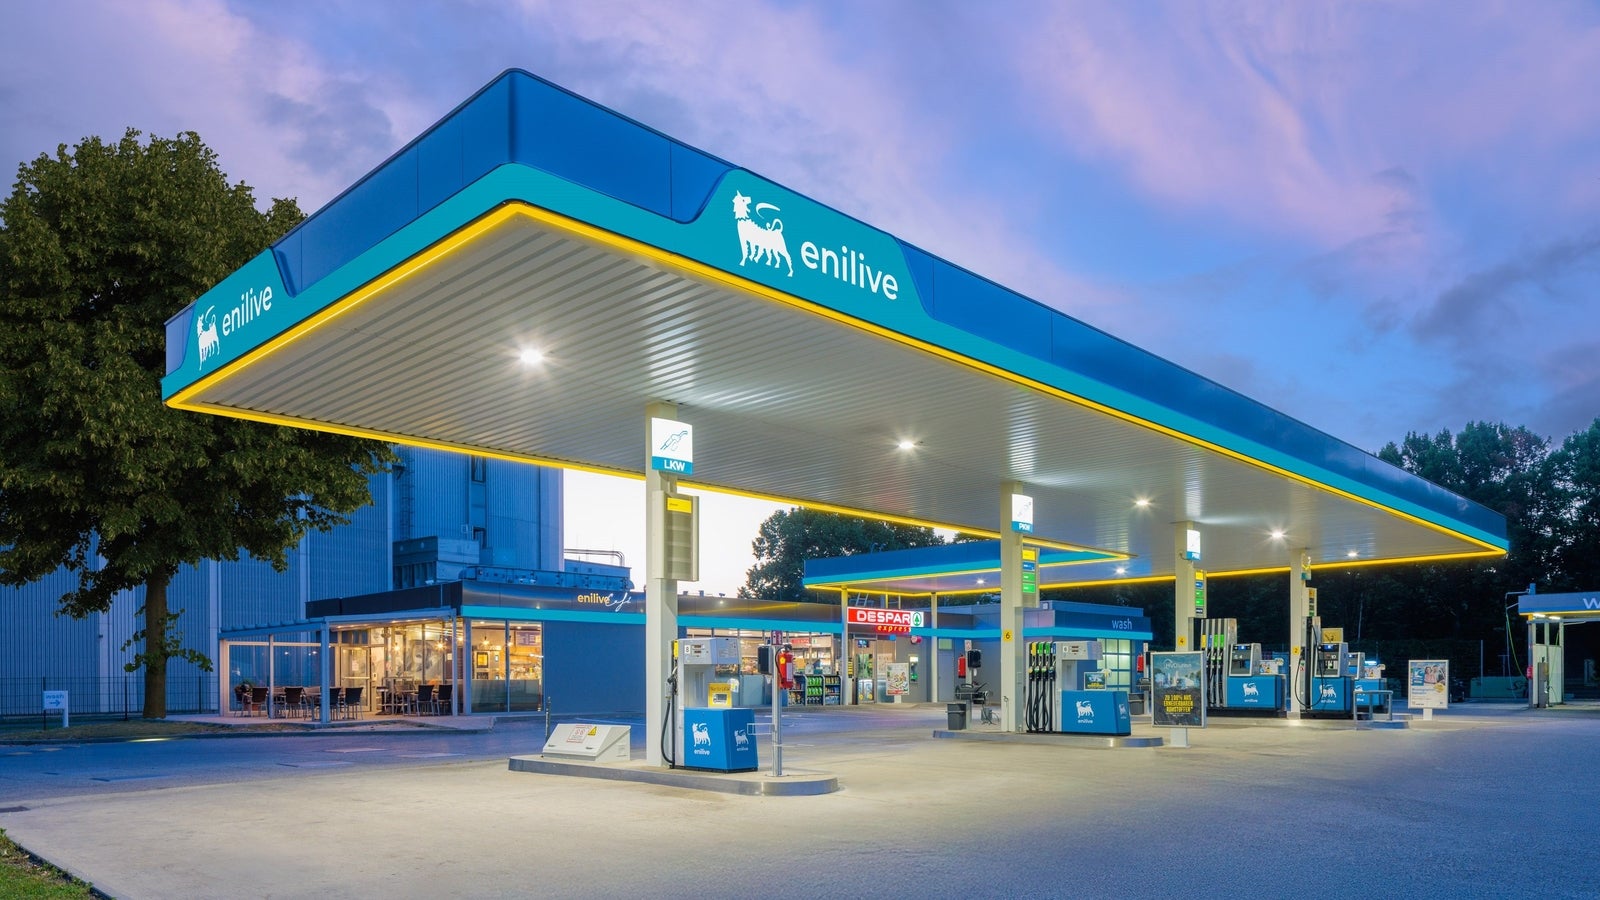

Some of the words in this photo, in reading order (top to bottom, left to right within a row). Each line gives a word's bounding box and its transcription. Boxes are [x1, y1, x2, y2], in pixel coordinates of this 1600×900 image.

[800, 241, 899, 300] enilive
[222, 285, 273, 337] enilive
[663, 459, 686, 472] LKW
[577, 592, 610, 605] enilive
[856, 610, 911, 623] DESPAR
[1111, 617, 1133, 630] wash
[1005, 631, 1011, 639] 6
[693, 748, 711, 756] enilive
